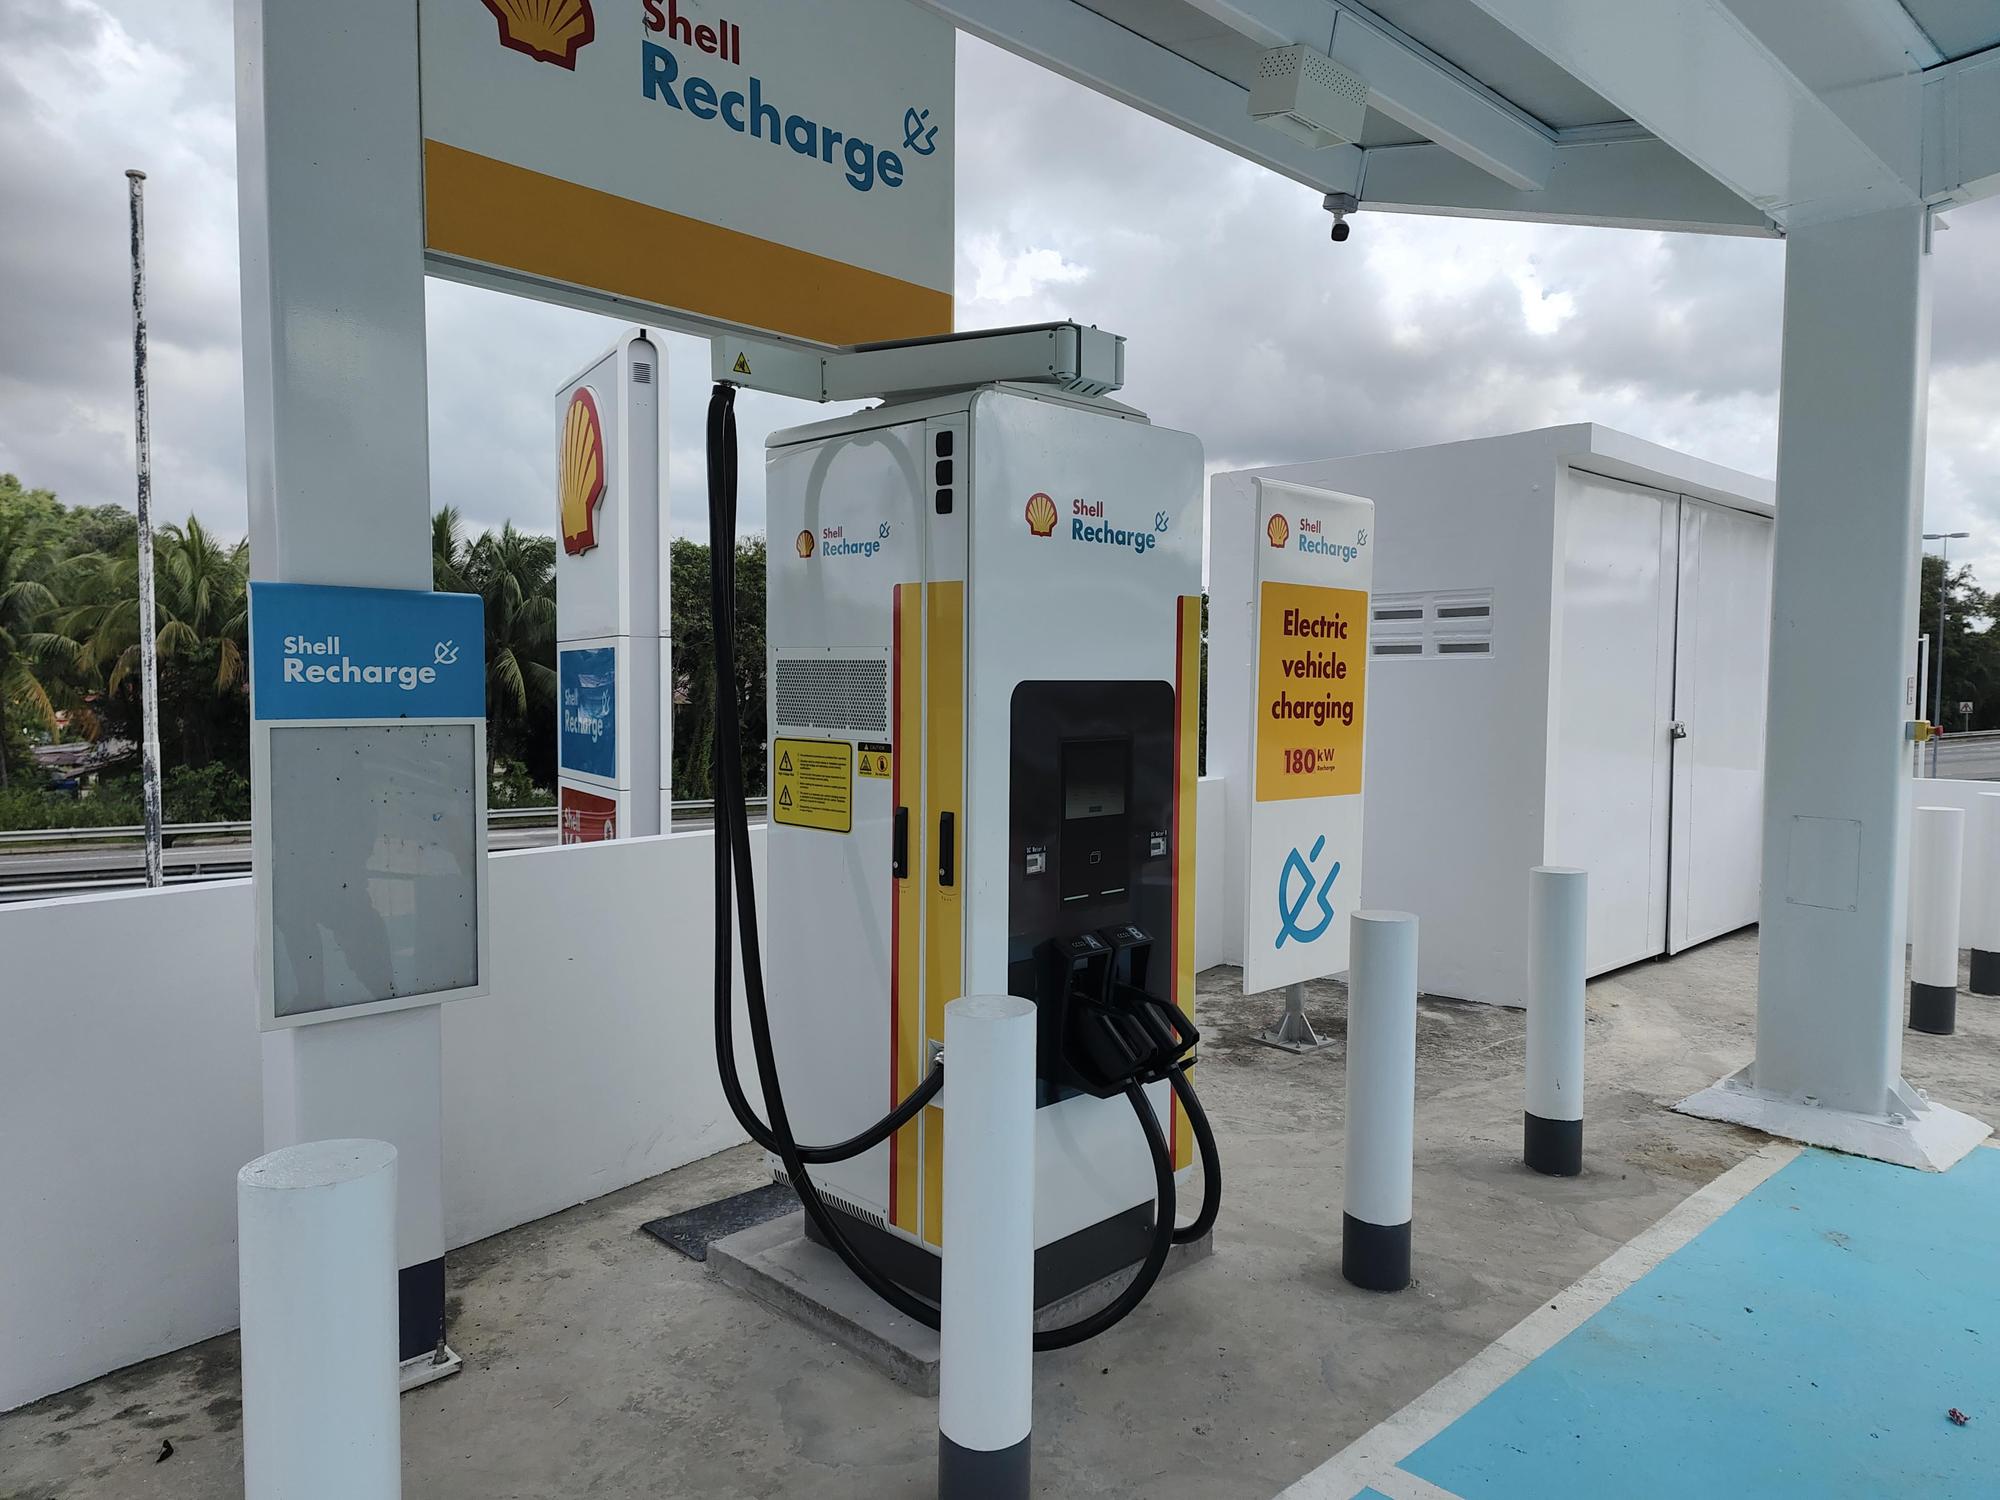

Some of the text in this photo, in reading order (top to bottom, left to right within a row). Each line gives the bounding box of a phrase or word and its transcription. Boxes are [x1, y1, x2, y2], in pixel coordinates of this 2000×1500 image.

[642, 0, 740, 65] Shell
[642, 40, 904, 192] Recharge
[1072, 499, 1104, 518] Shell
[823, 527, 843, 540] Shell
[1072, 518, 1156, 554] Recharge
[1299, 518, 1322, 534] Shell
[822, 539, 880, 558] Recharge
[1299, 534, 1358, 563] Recharge
[1283, 609, 1348, 640] Electric
[283, 636, 340, 656] Shell
[283, 657, 437, 691] Recharge
[1282, 651, 1347, 680] vehicle
[565, 688, 579, 706] Shell
[1271, 691, 1354, 727] charging
[565, 709, 603, 743] Recharge
[1285, 748, 1335, 774] 180 kW
[565, 806, 581, 833] Shell
